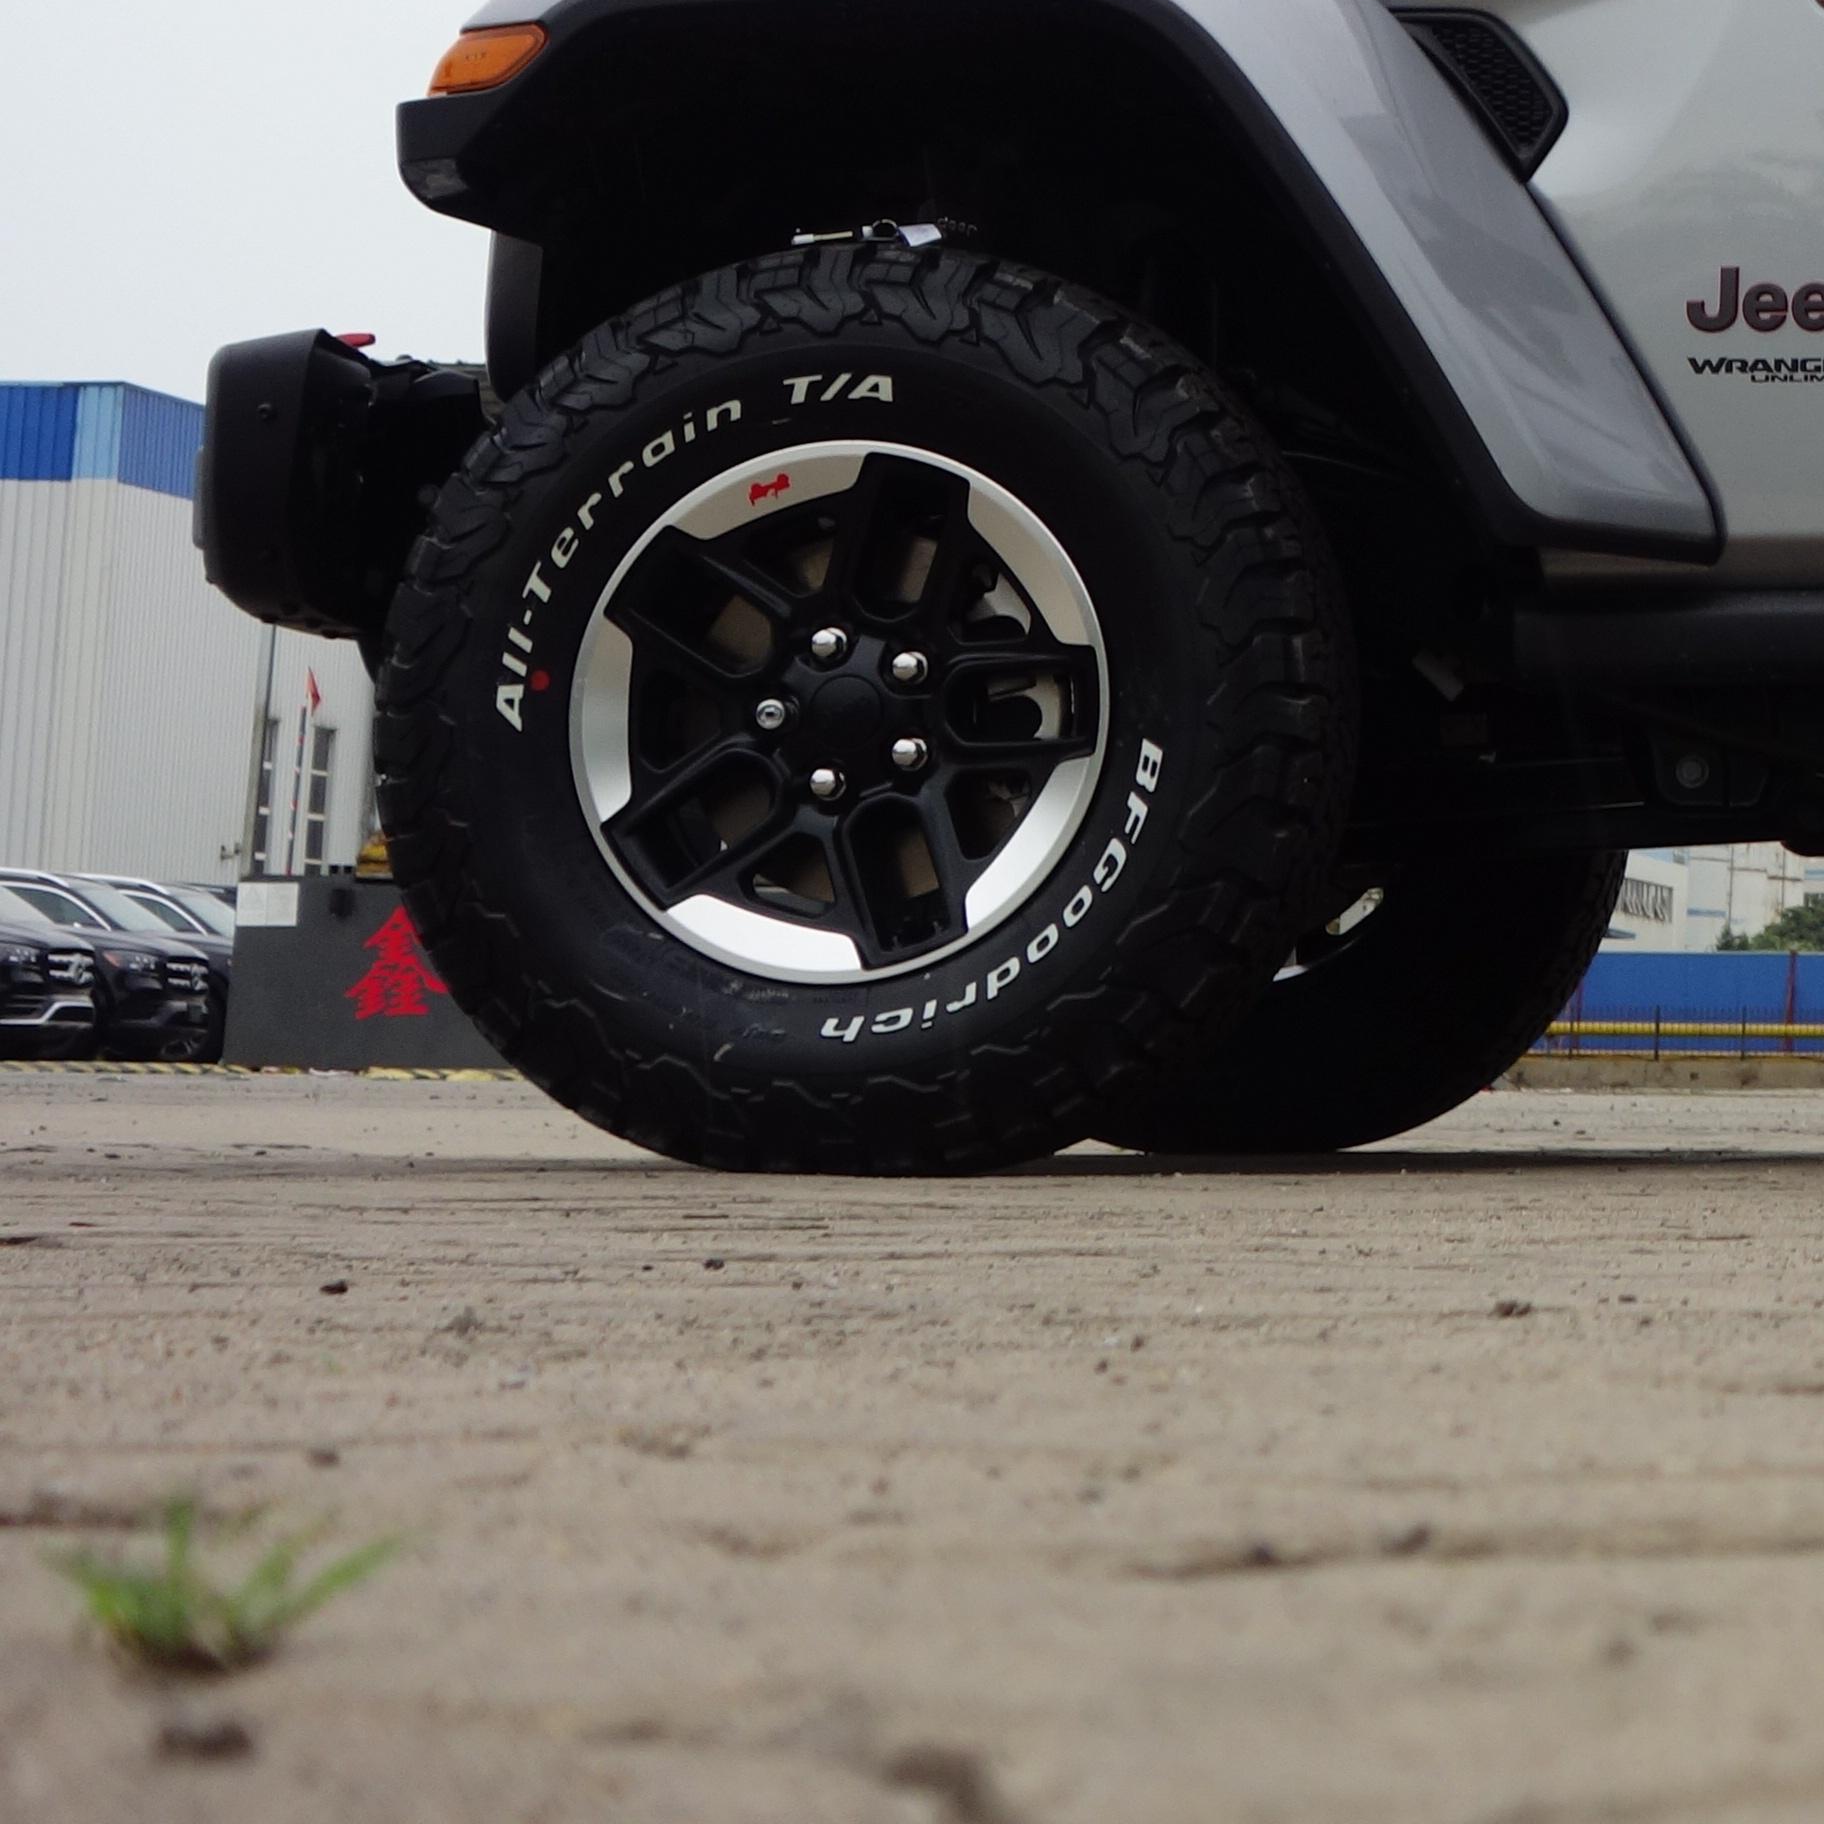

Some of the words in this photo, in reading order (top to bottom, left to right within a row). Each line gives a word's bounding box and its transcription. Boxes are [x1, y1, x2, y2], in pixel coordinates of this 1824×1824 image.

[496, 399, 742, 732] All-Terrain
[783, 373, 893, 405] T/A
[820, 738, 1163, 1042] BFGoodrich
